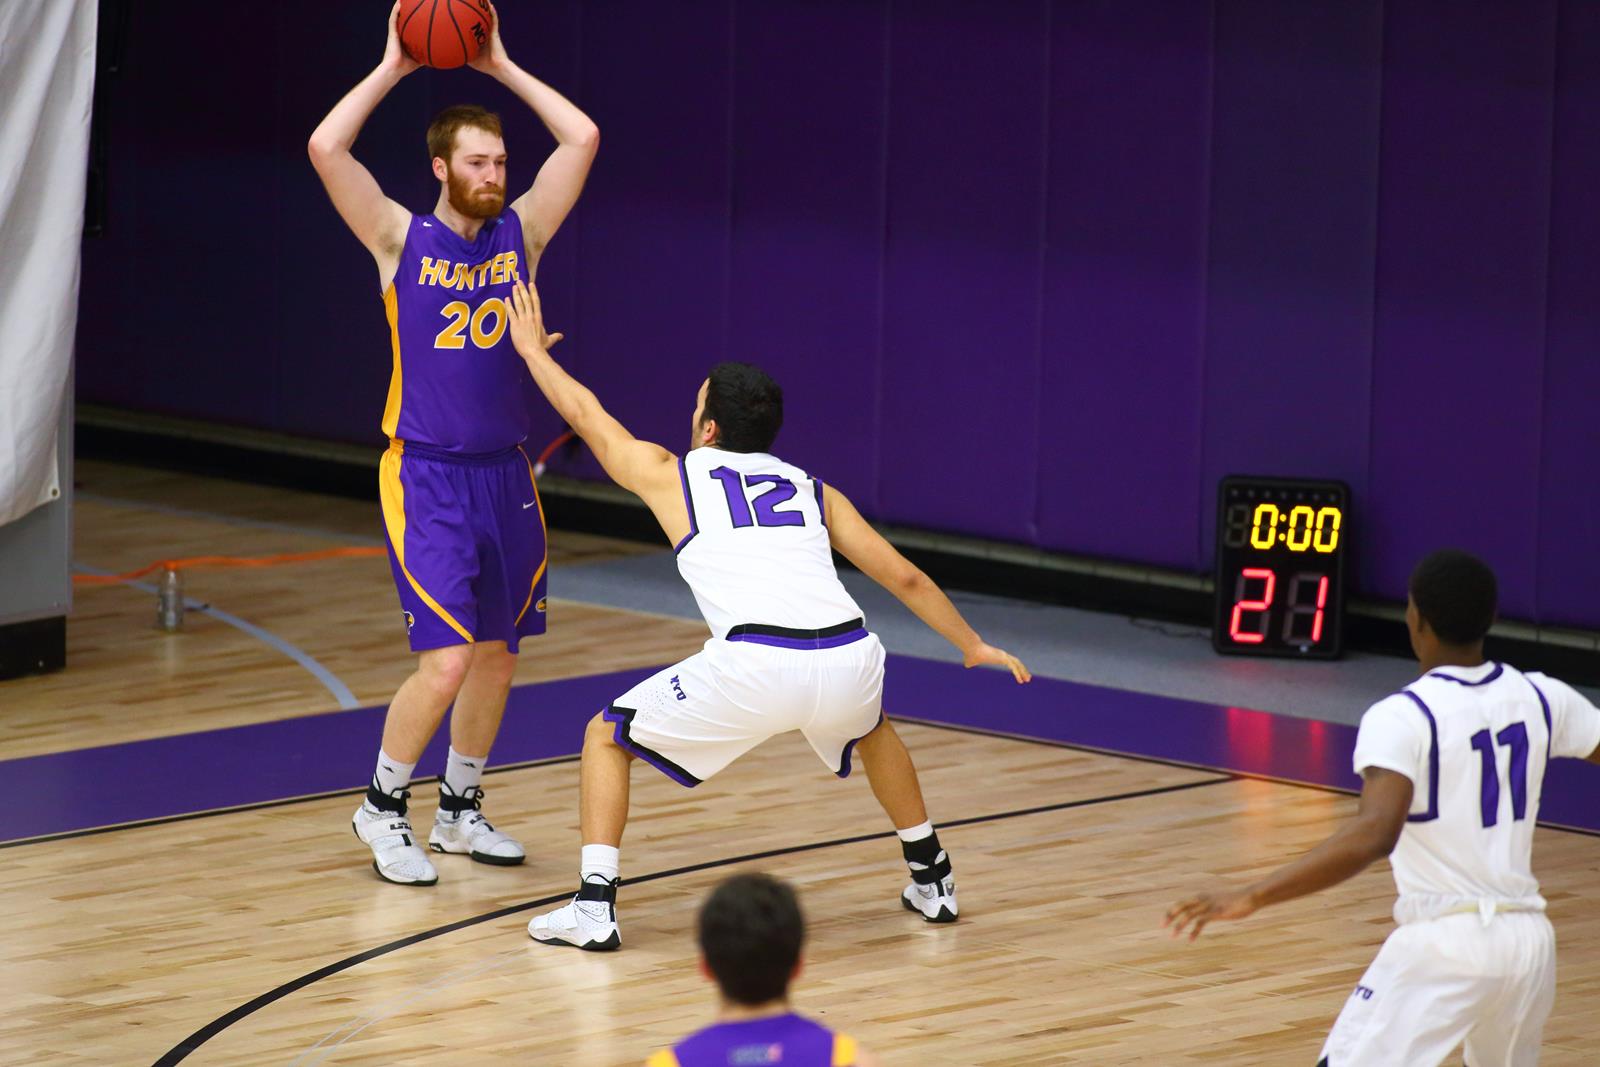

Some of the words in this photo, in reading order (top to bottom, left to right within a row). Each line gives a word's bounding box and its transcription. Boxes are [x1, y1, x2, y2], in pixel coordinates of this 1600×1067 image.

[418, 251, 519, 291] HUNTER
[434, 298, 508, 349] 20
[709, 466, 805, 528] 12
[1251, 504, 1341, 552] 0:00
[1230, 568, 1329, 643] 21
[1471, 721, 1529, 828] 11
